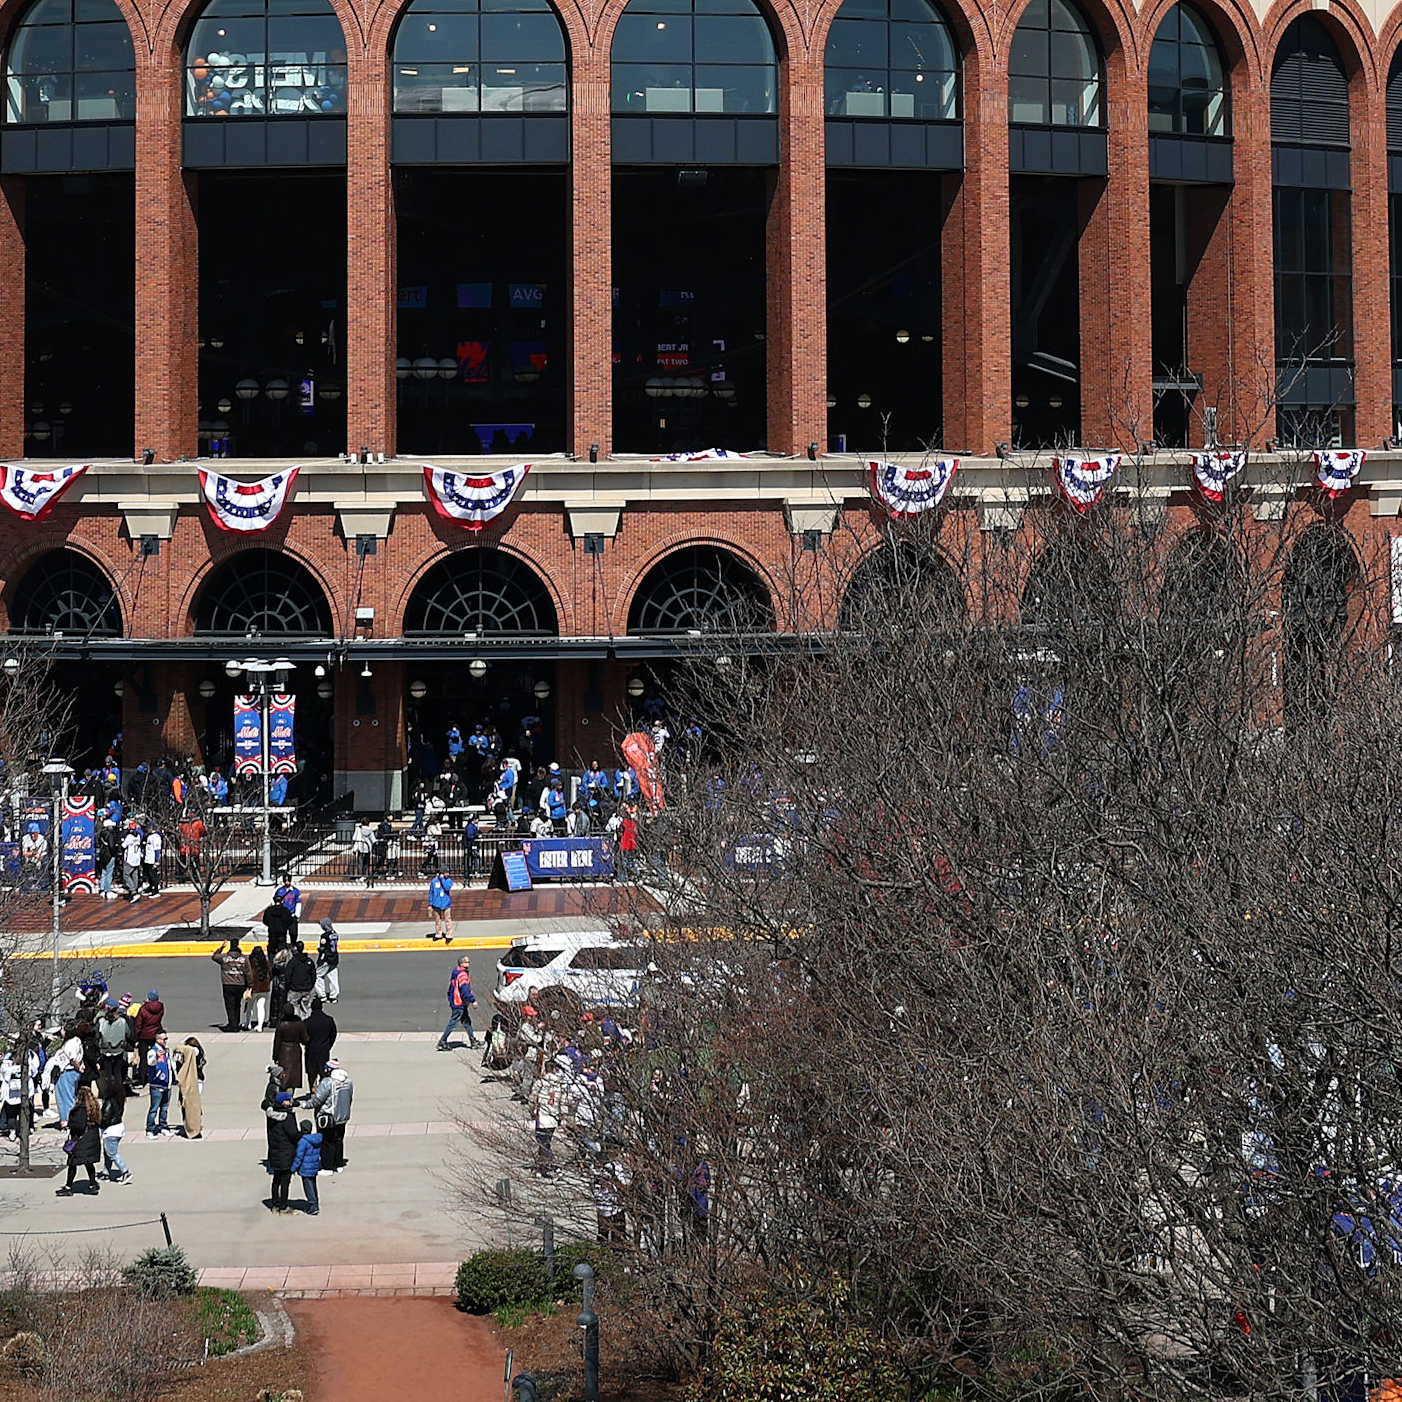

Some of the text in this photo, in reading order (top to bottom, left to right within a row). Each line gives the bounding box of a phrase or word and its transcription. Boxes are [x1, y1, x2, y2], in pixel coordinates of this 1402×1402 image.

[512, 287, 543, 301] AVG
[539, 850, 594, 869] ENTER HERE
